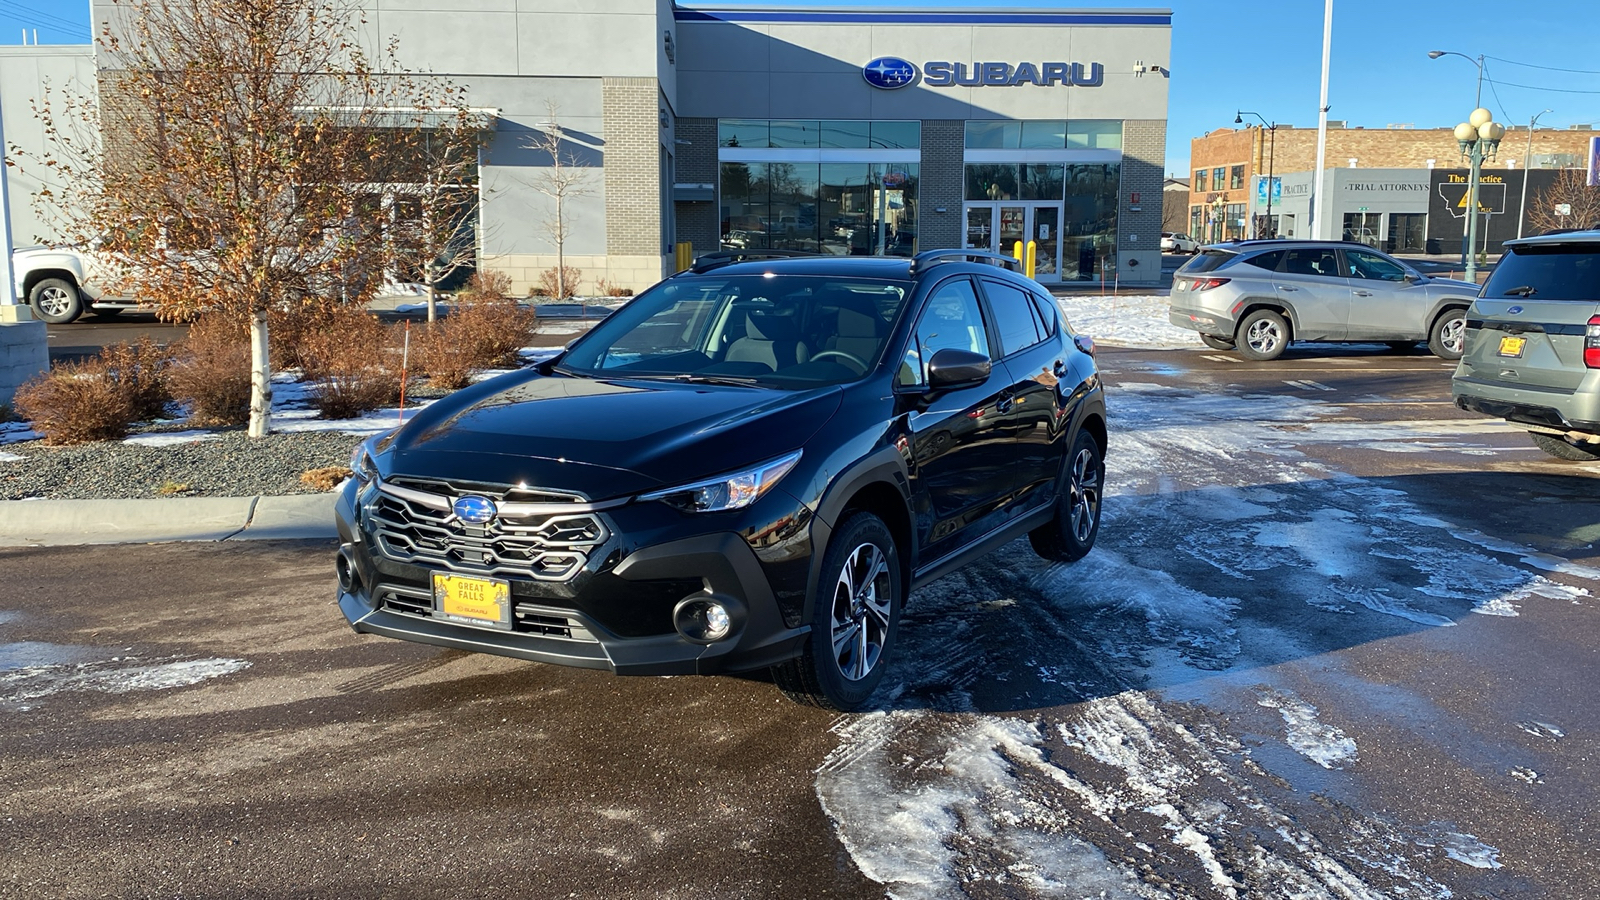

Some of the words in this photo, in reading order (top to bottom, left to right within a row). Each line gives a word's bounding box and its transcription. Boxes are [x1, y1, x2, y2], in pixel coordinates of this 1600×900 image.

[923, 62, 1101, 86] SUBARU
[1448, 174, 1465, 183] The
[1283, 184, 1308, 195] PRACTICE
[1348, 183, 1376, 191] TRIAL
[1378, 183, 1429, 191] ATTORNEYS
[458, 581, 484, 592] GREAT
[458, 590, 485, 601] FALLS
